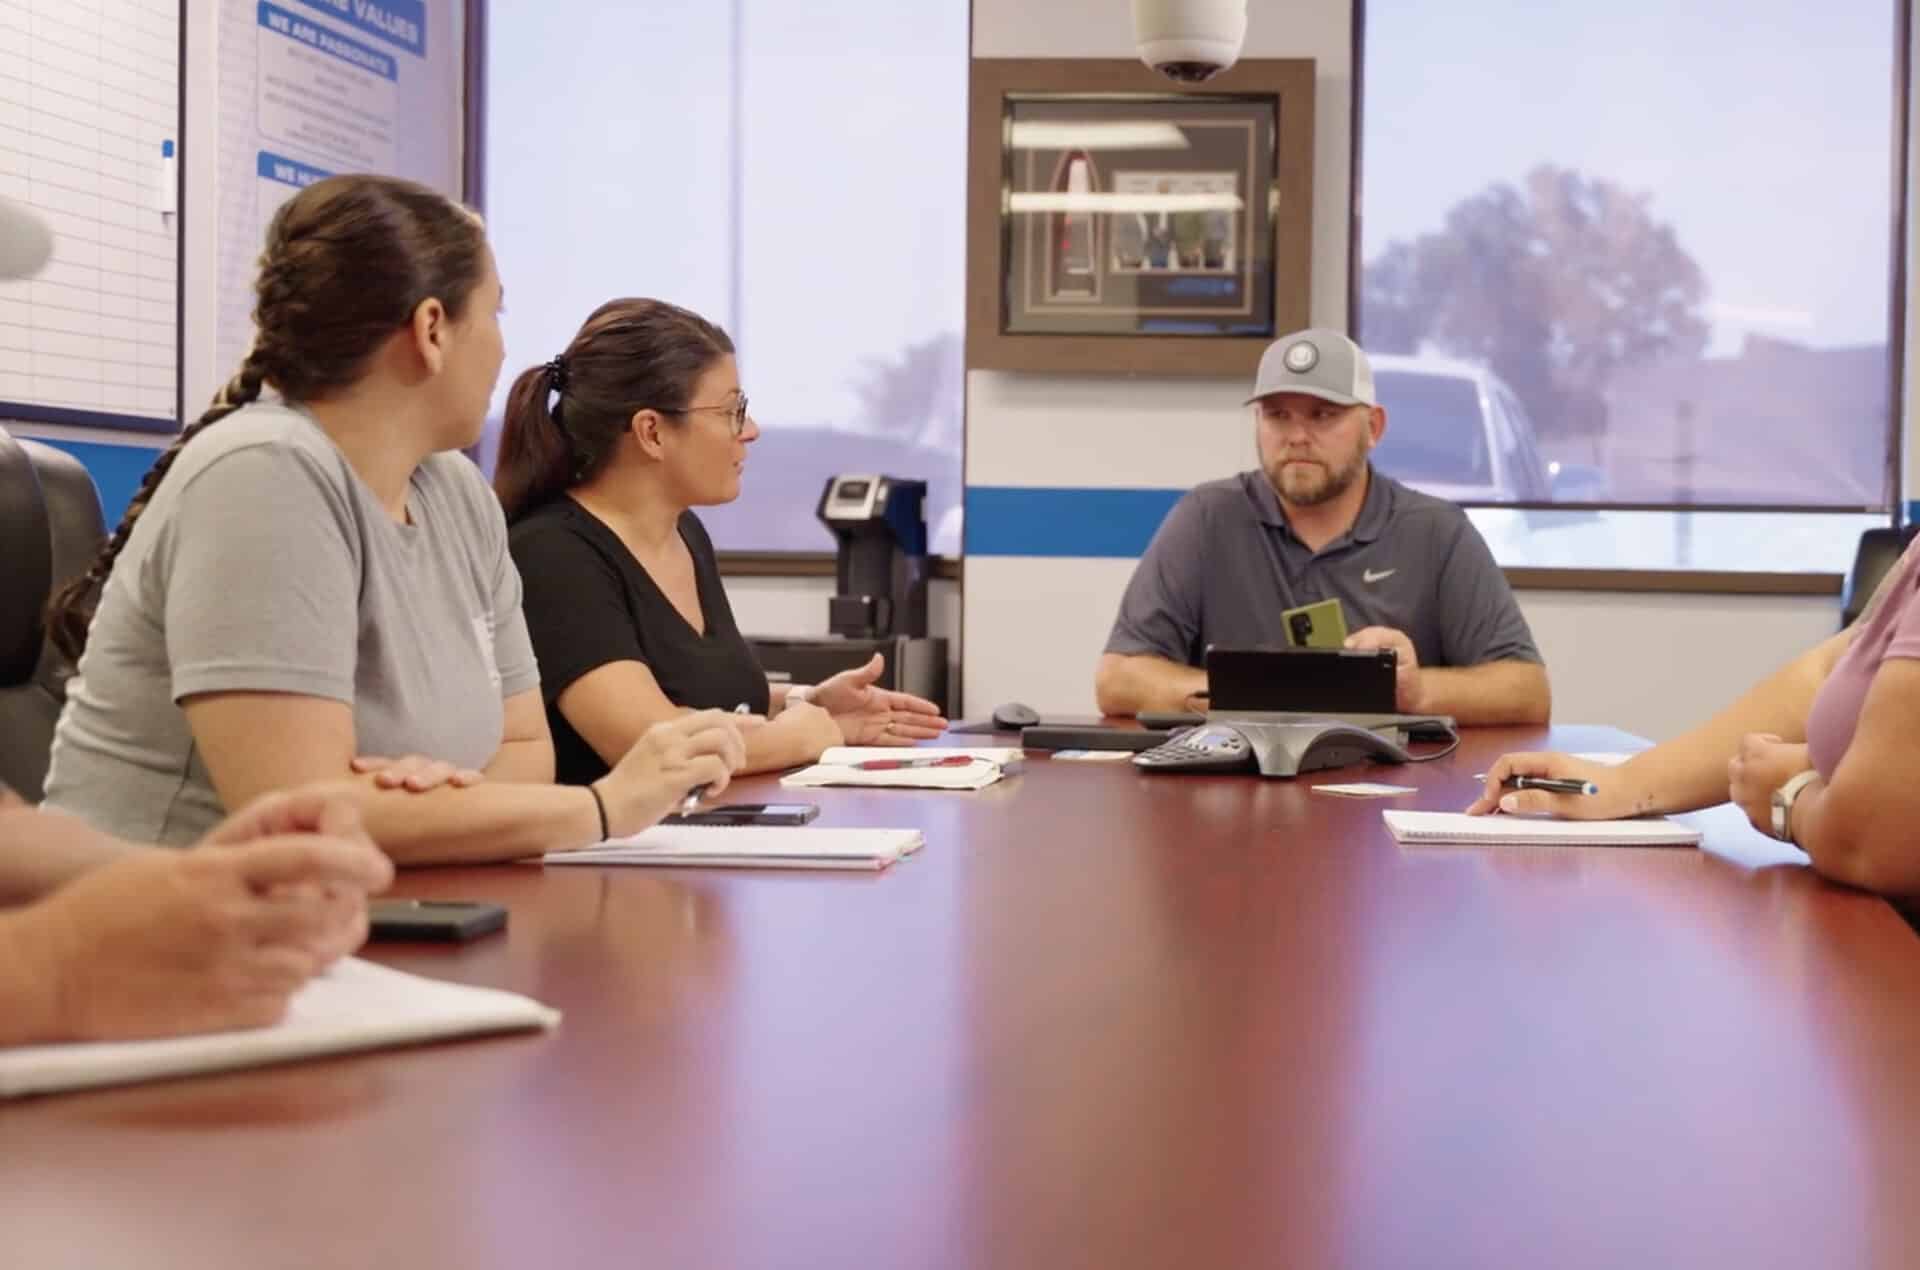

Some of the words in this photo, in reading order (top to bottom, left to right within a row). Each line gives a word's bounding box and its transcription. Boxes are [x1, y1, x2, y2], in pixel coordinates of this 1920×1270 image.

[268, 10, 289, 33] WE
[292, 22, 317, 44] ARE
[352, 0, 418, 45] VALUES
[273, 163, 295, 184] WE
